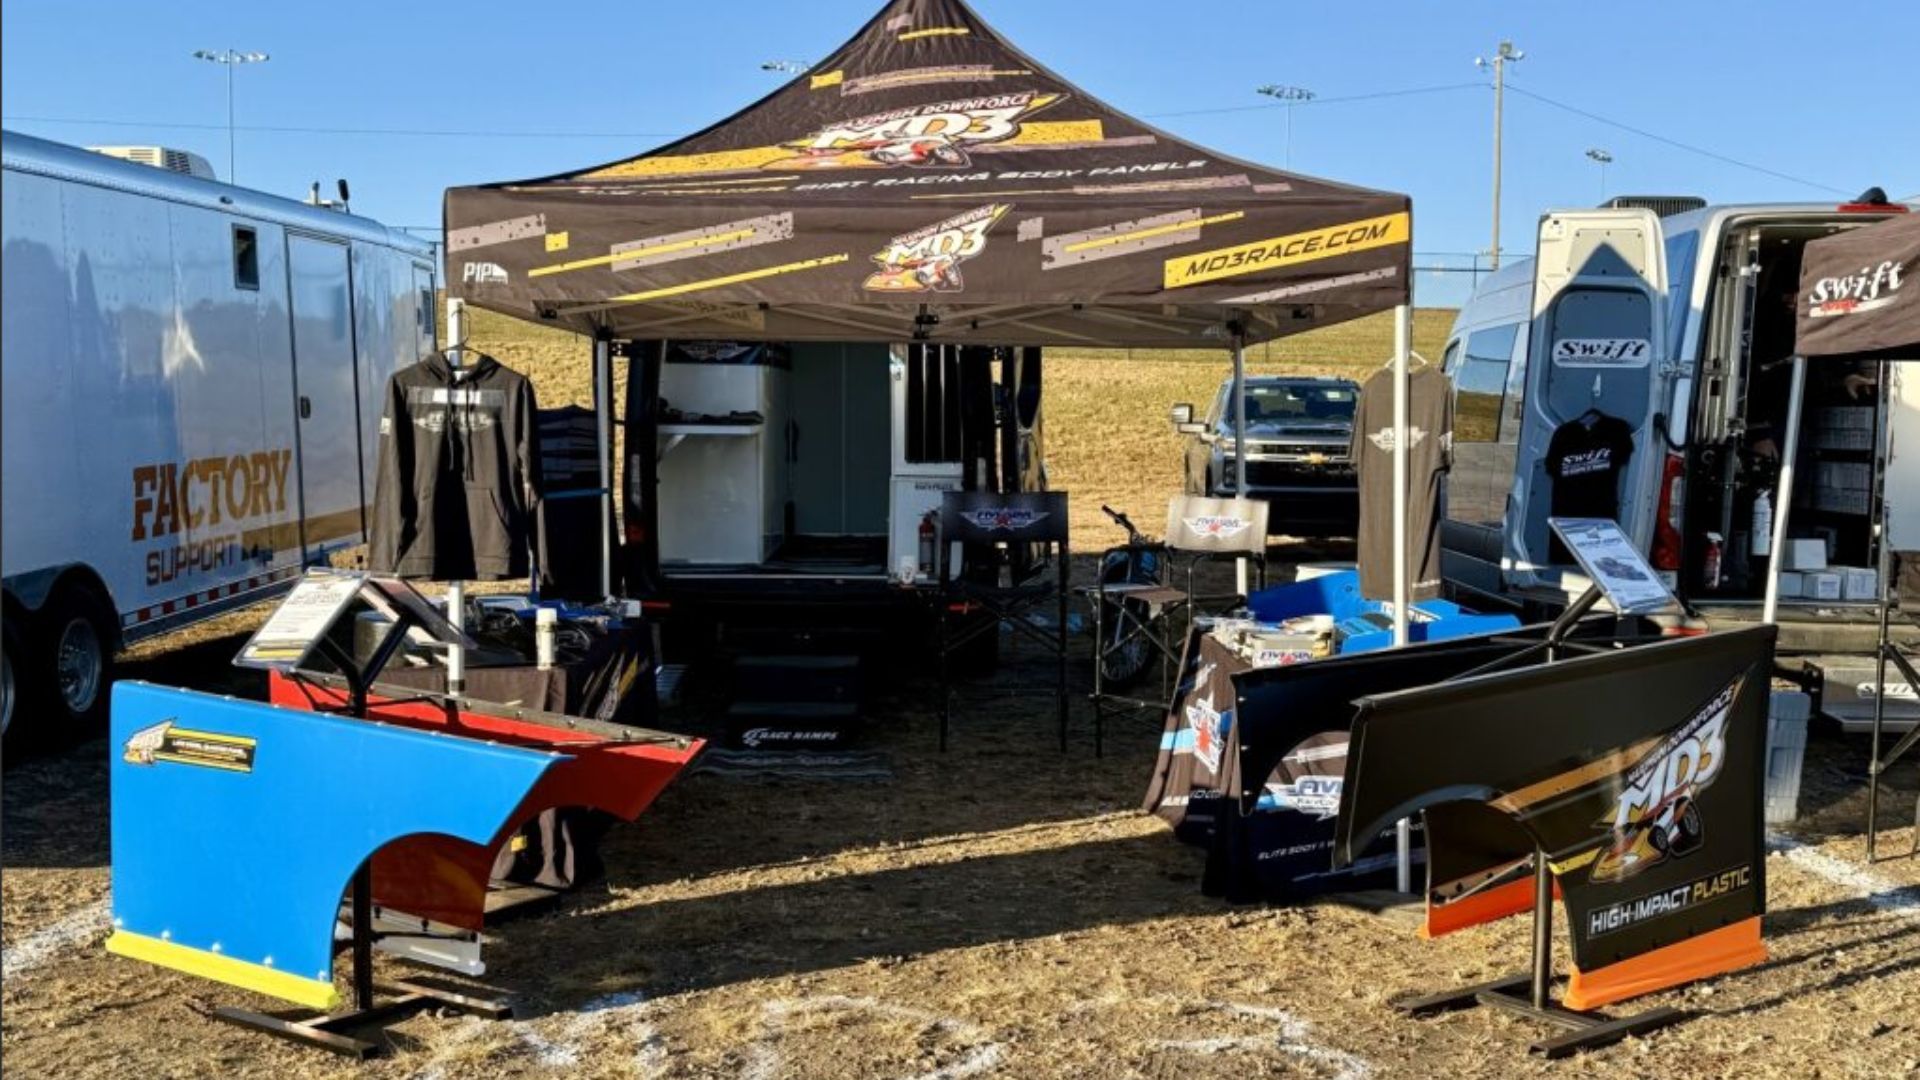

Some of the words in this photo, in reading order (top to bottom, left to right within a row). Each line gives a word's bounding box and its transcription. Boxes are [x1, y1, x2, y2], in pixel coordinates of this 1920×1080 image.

[814, 106, 1026, 149] MD3
[922, 92, 1032, 116] DOWNFORCE
[873, 171, 990, 187] RACING
[997, 168, 1083, 180] BODY
[1089, 160, 1208, 176] PANELS
[887, 217, 991, 265] MD3
[1186, 221, 1392, 278] MD3RACE.COM
[132, 449, 293, 542] FACTORY
[146, 534, 237, 586] SUPPORT
[759, 731, 790, 740] RACE
[1614, 704, 1732, 830] MD3
[1591, 886, 1691, 934] HIGH-IMPACT
[1692, 866, 1750, 900] PLASTIC
